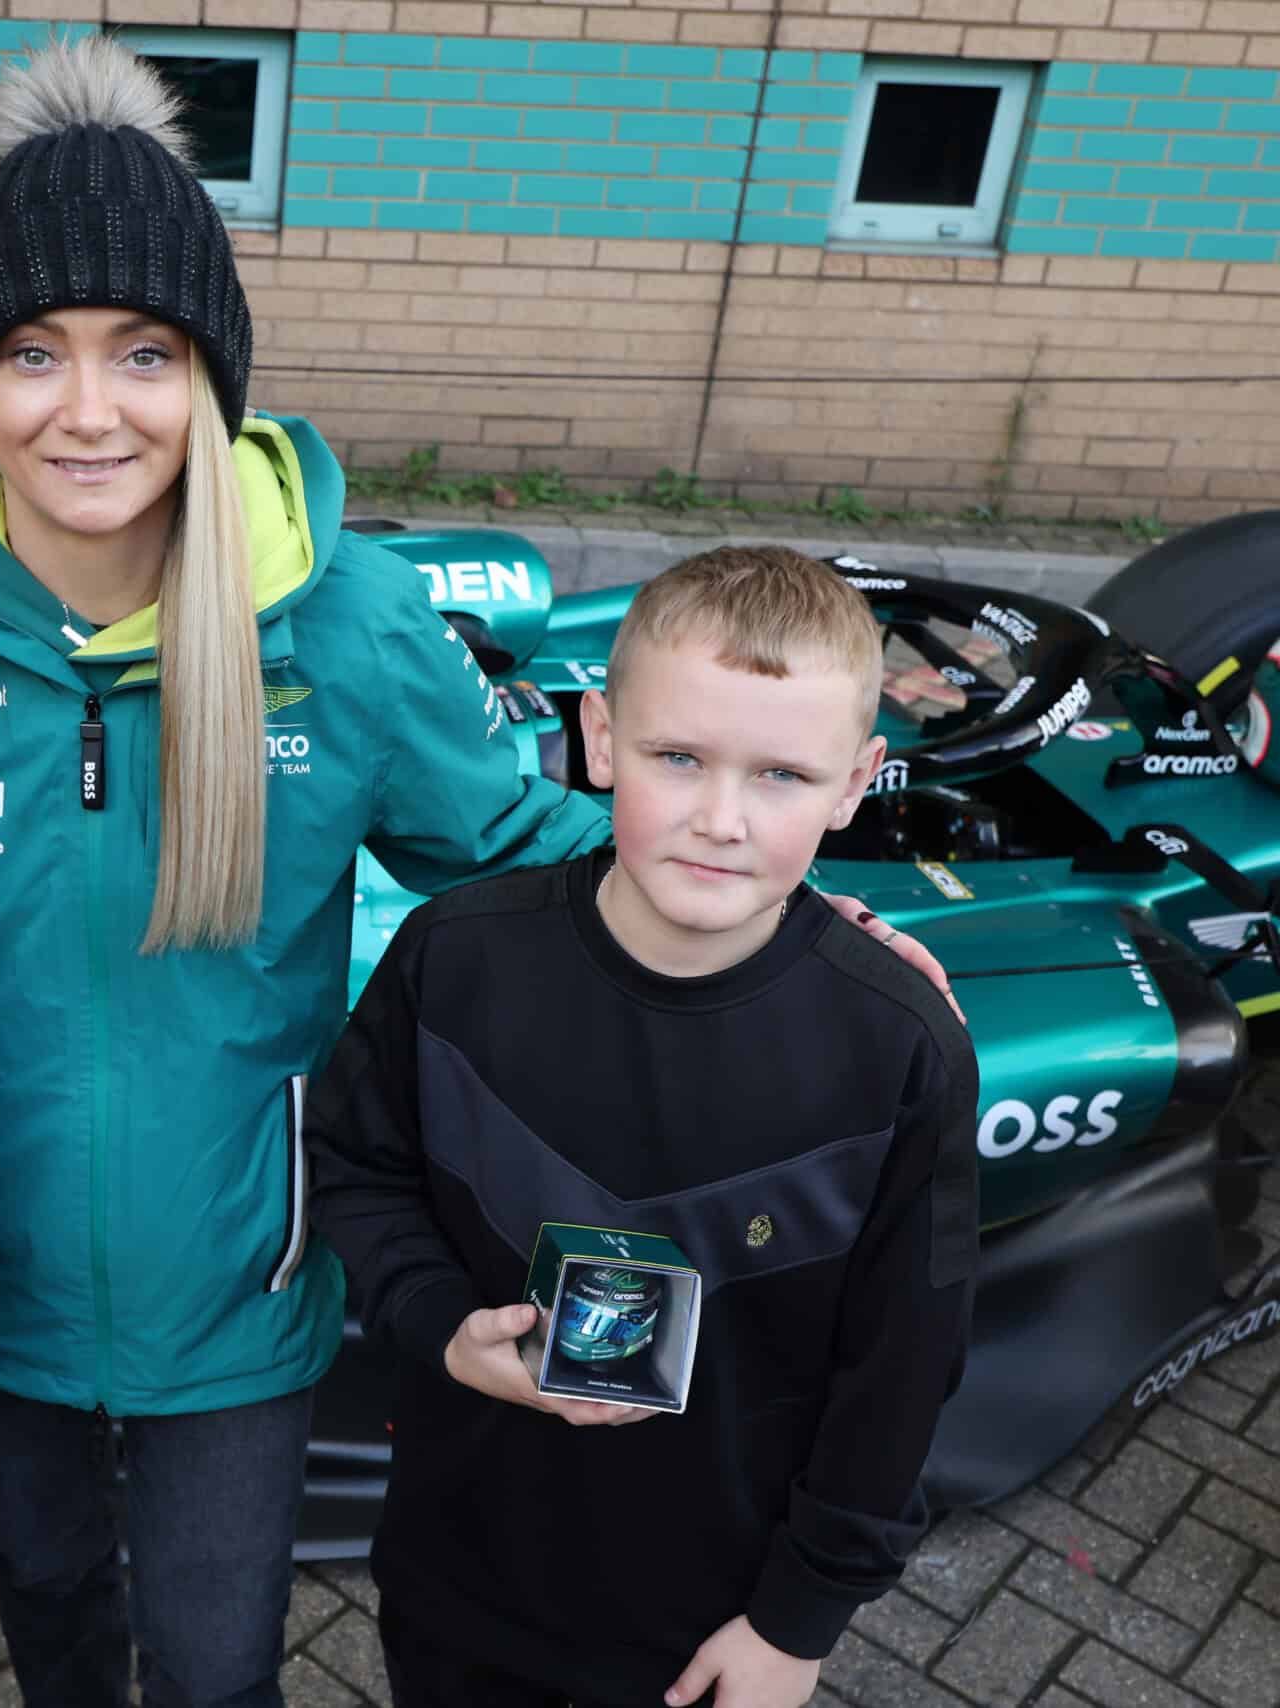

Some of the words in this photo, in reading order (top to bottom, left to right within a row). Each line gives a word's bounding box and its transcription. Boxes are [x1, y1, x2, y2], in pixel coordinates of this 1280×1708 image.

[282, 763, 310, 774] TEAM
[1143, 754, 1238, 775] aramco
[84, 761, 96, 800] BOSS
[977, 1089, 1123, 1159] OSS
